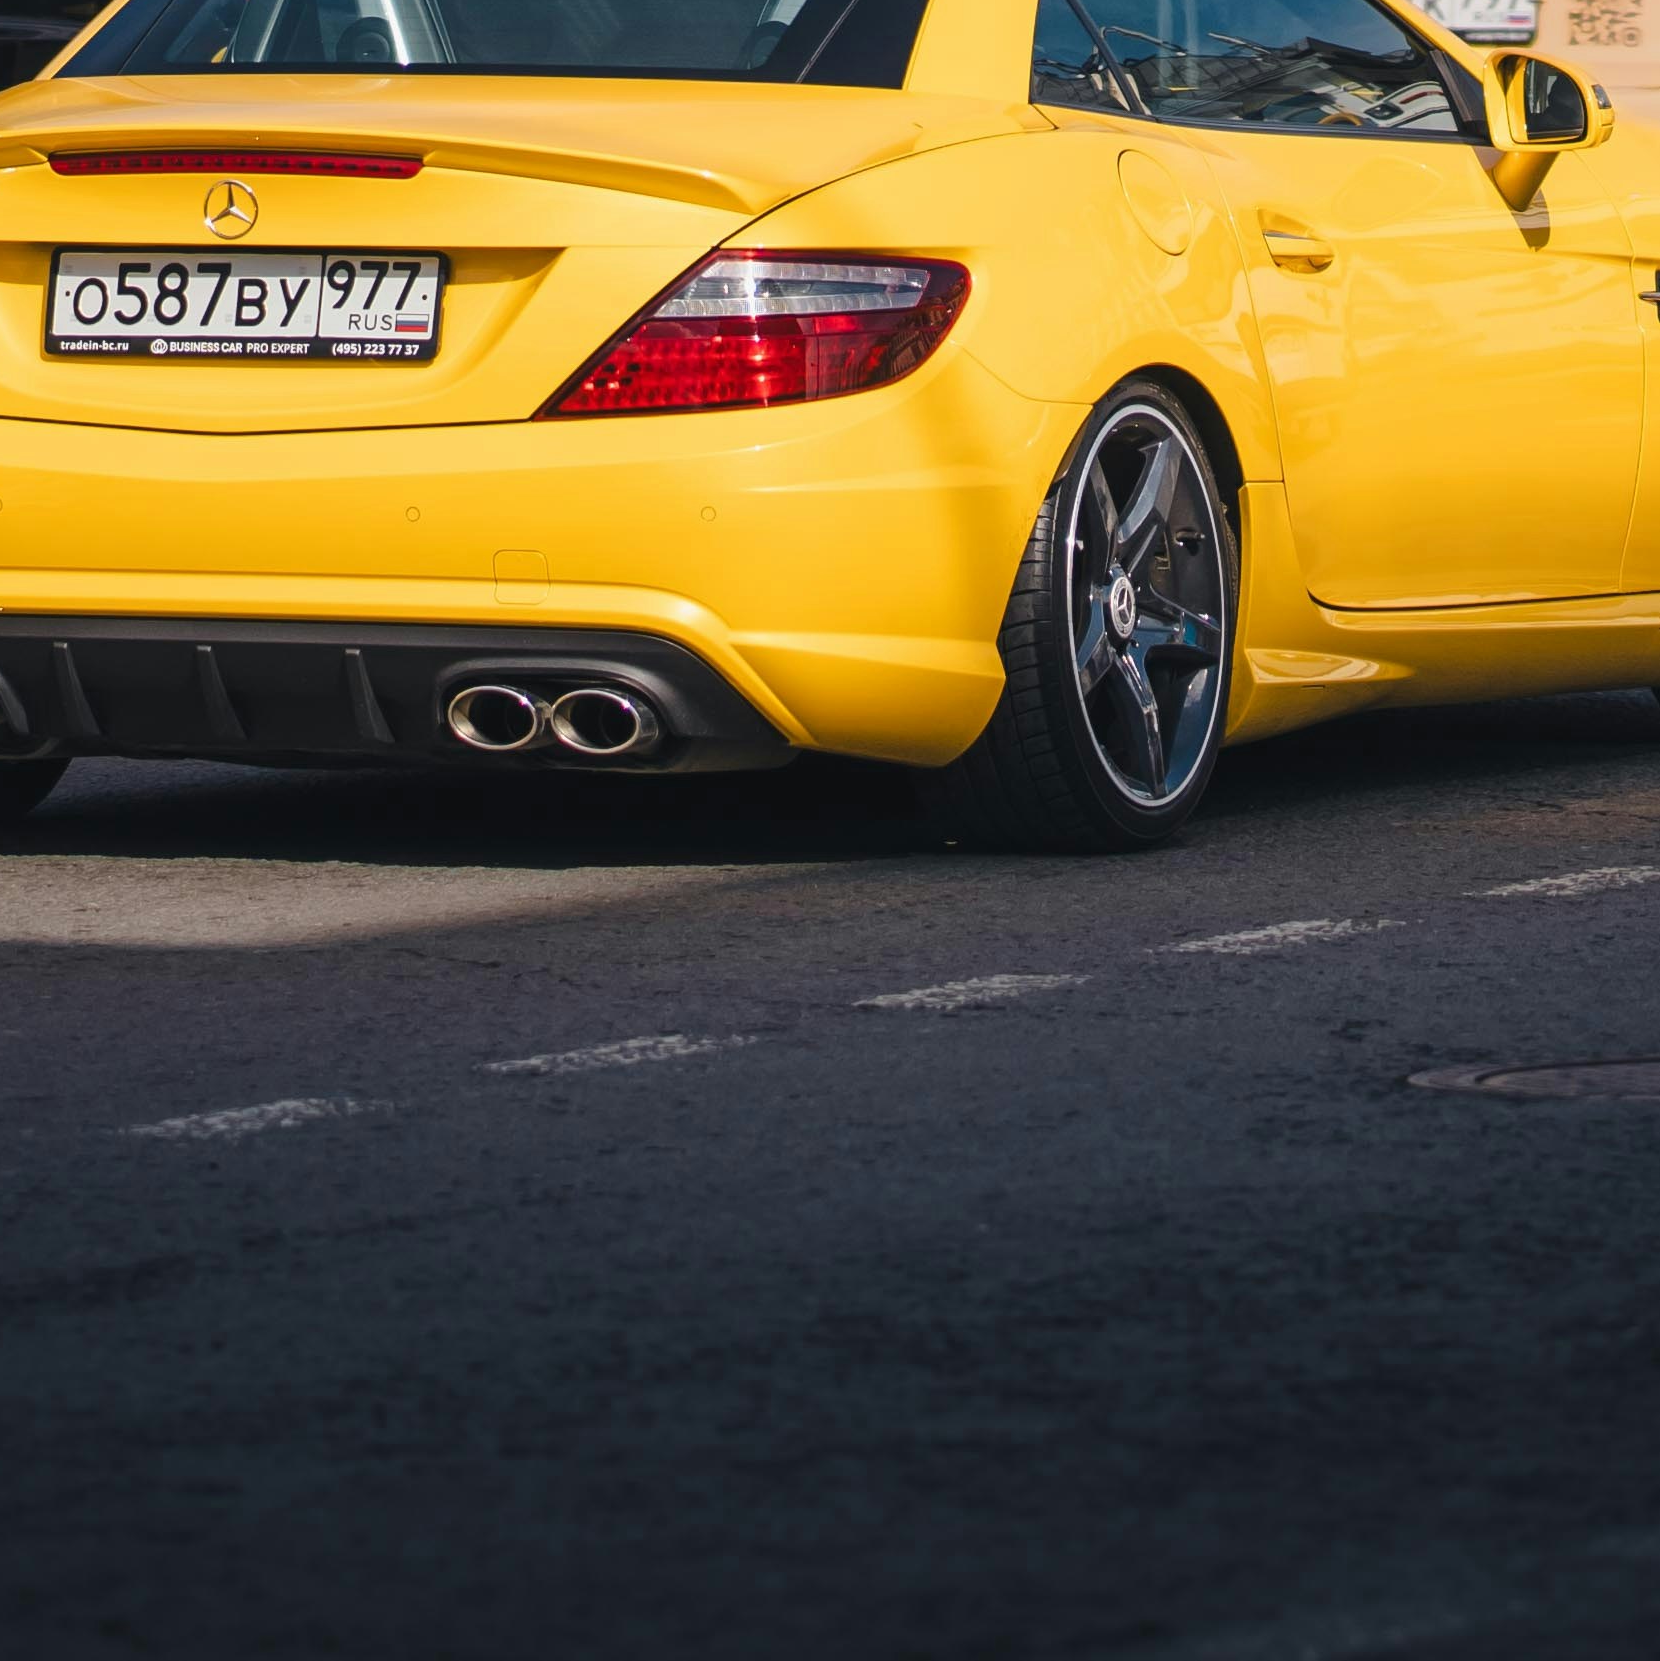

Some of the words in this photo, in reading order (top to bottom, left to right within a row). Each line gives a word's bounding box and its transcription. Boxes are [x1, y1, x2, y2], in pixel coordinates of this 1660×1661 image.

[326, 260, 423, 311] 977
[348, 313, 393, 332] RUS
[60, 340, 129, 352] tradein-bc.ru
[169, 341, 220, 353] BUSINESS
[221, 342, 243, 353] CAR
[247, 342, 269, 354] PRO
[271, 342, 310, 355] EXPERT
[332, 343, 362, 356] (495)
[364, 344, 385, 355] 223
[387, 344, 401, 355] 77
[404, 345, 420, 356] 37
